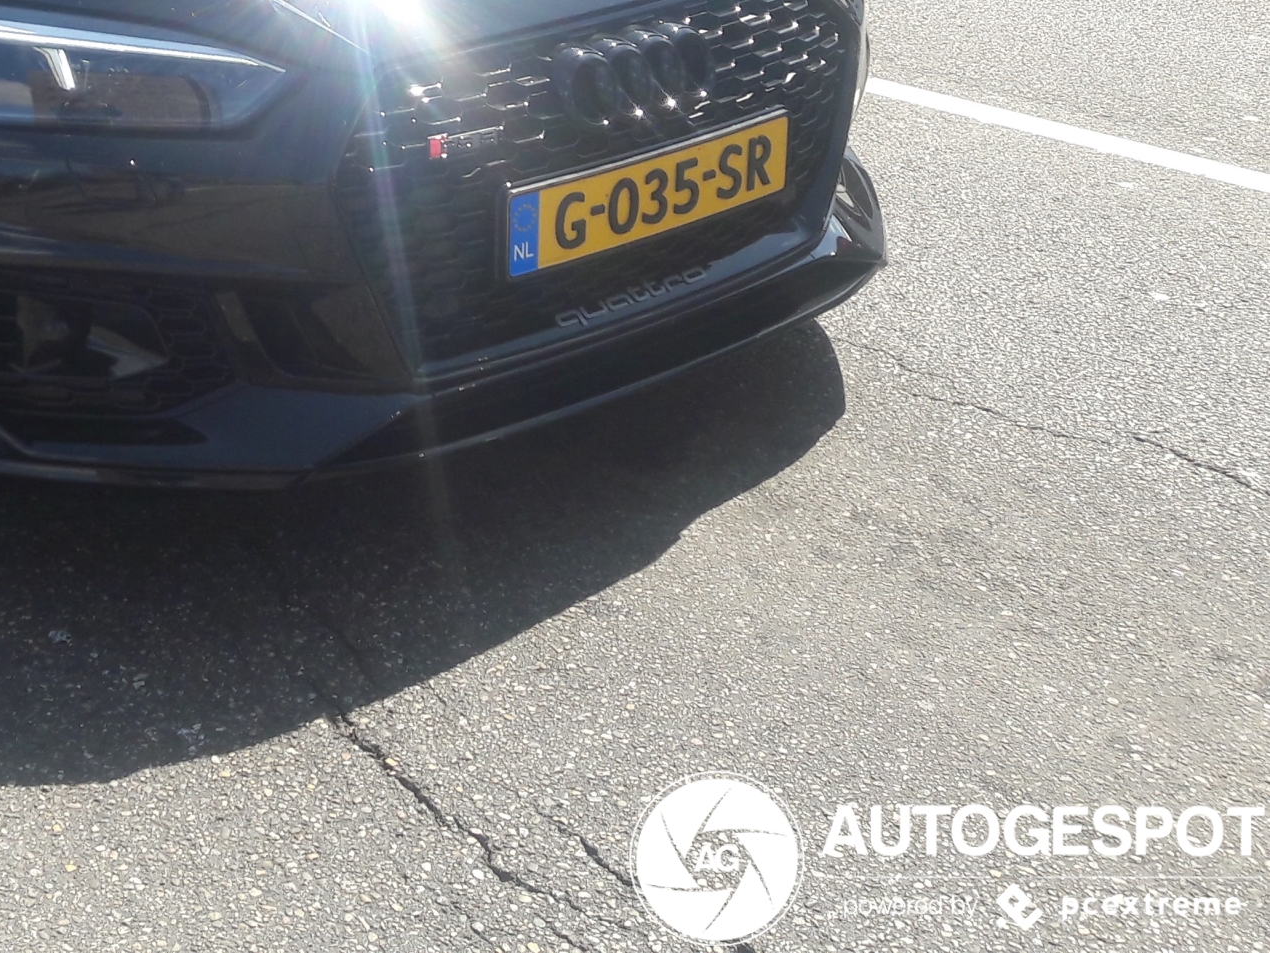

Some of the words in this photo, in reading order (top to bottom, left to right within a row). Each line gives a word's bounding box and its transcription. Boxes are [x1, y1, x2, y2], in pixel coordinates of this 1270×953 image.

[555, 135, 772, 249] G-035-SR
[513, 241, 534, 261] NL
[555, 266, 707, 327] quattro
